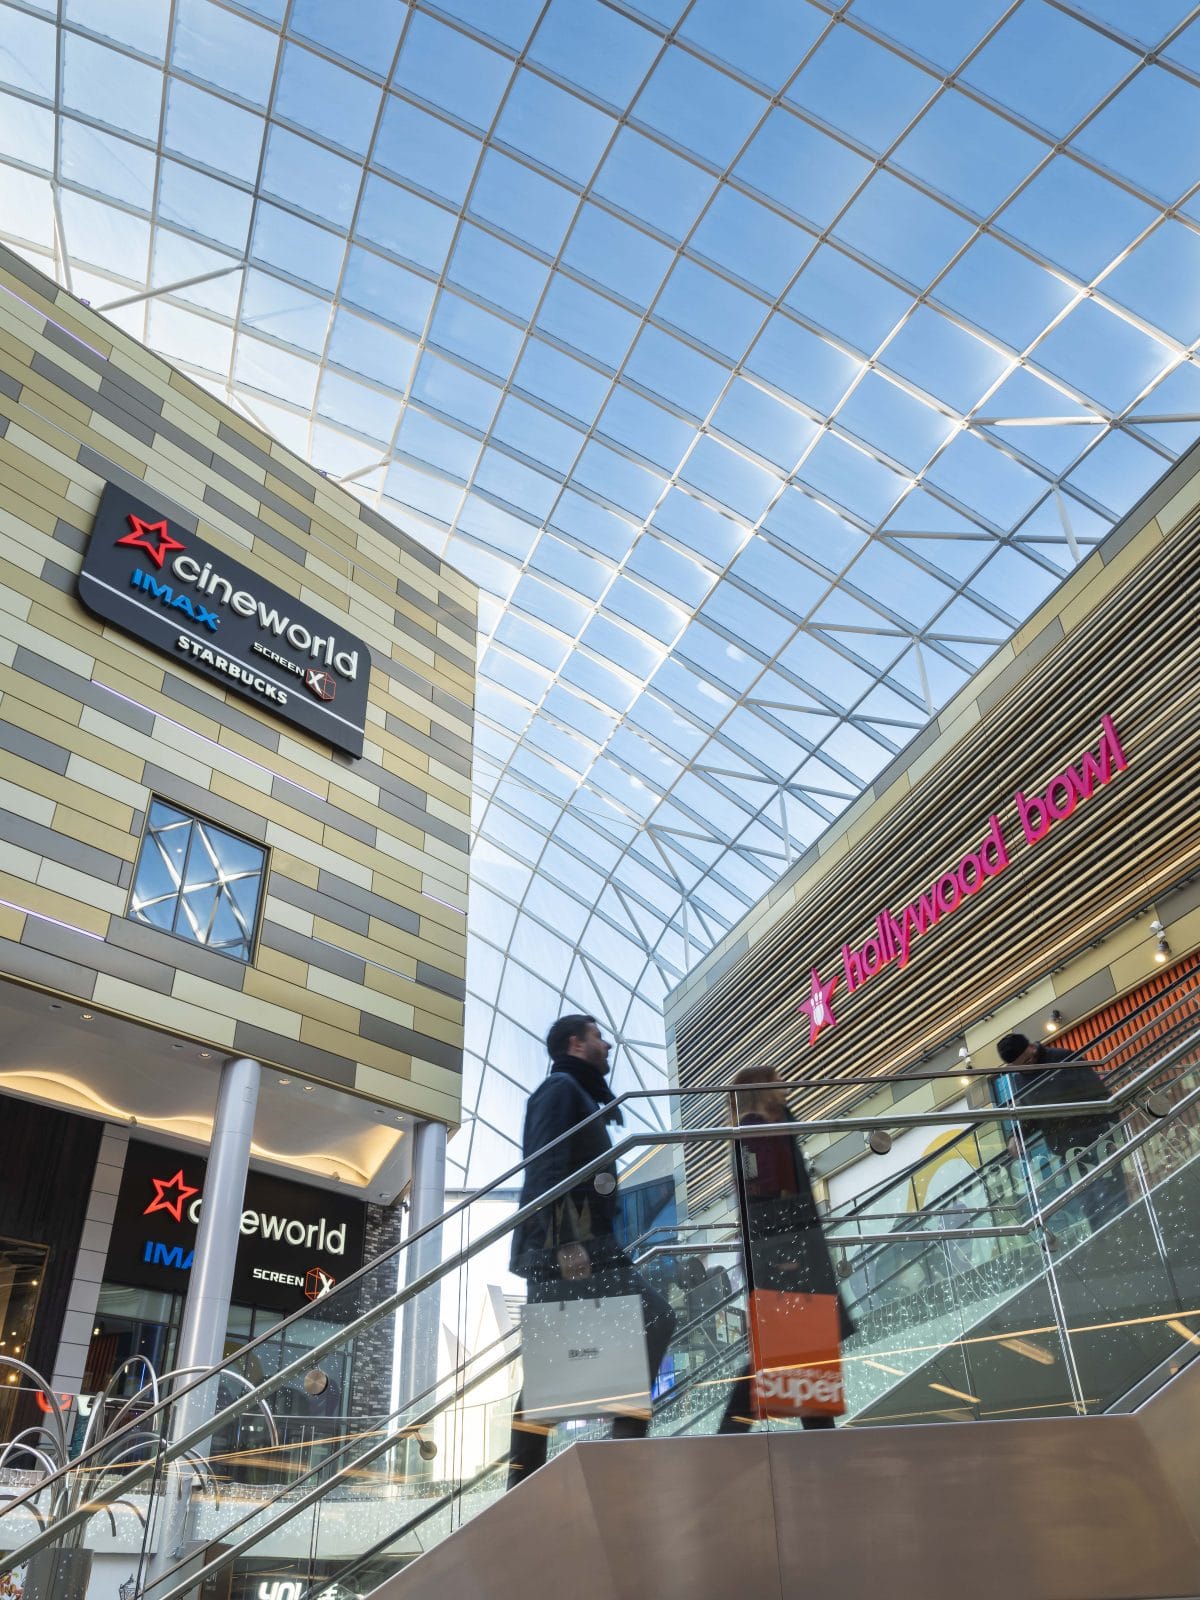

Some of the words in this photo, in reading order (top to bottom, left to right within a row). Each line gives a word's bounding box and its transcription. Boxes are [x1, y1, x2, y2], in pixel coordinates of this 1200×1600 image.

[130, 568, 219, 633] IMAX
[171, 555, 358, 681] cineworld
[176, 634, 289, 706] STARBUCKS
[842, 815, 1009, 993] hollywood
[1015, 713, 1129, 846] bowl
[144, 1240, 195, 1270] IM
[187, 1198, 347, 1256] ceworld
